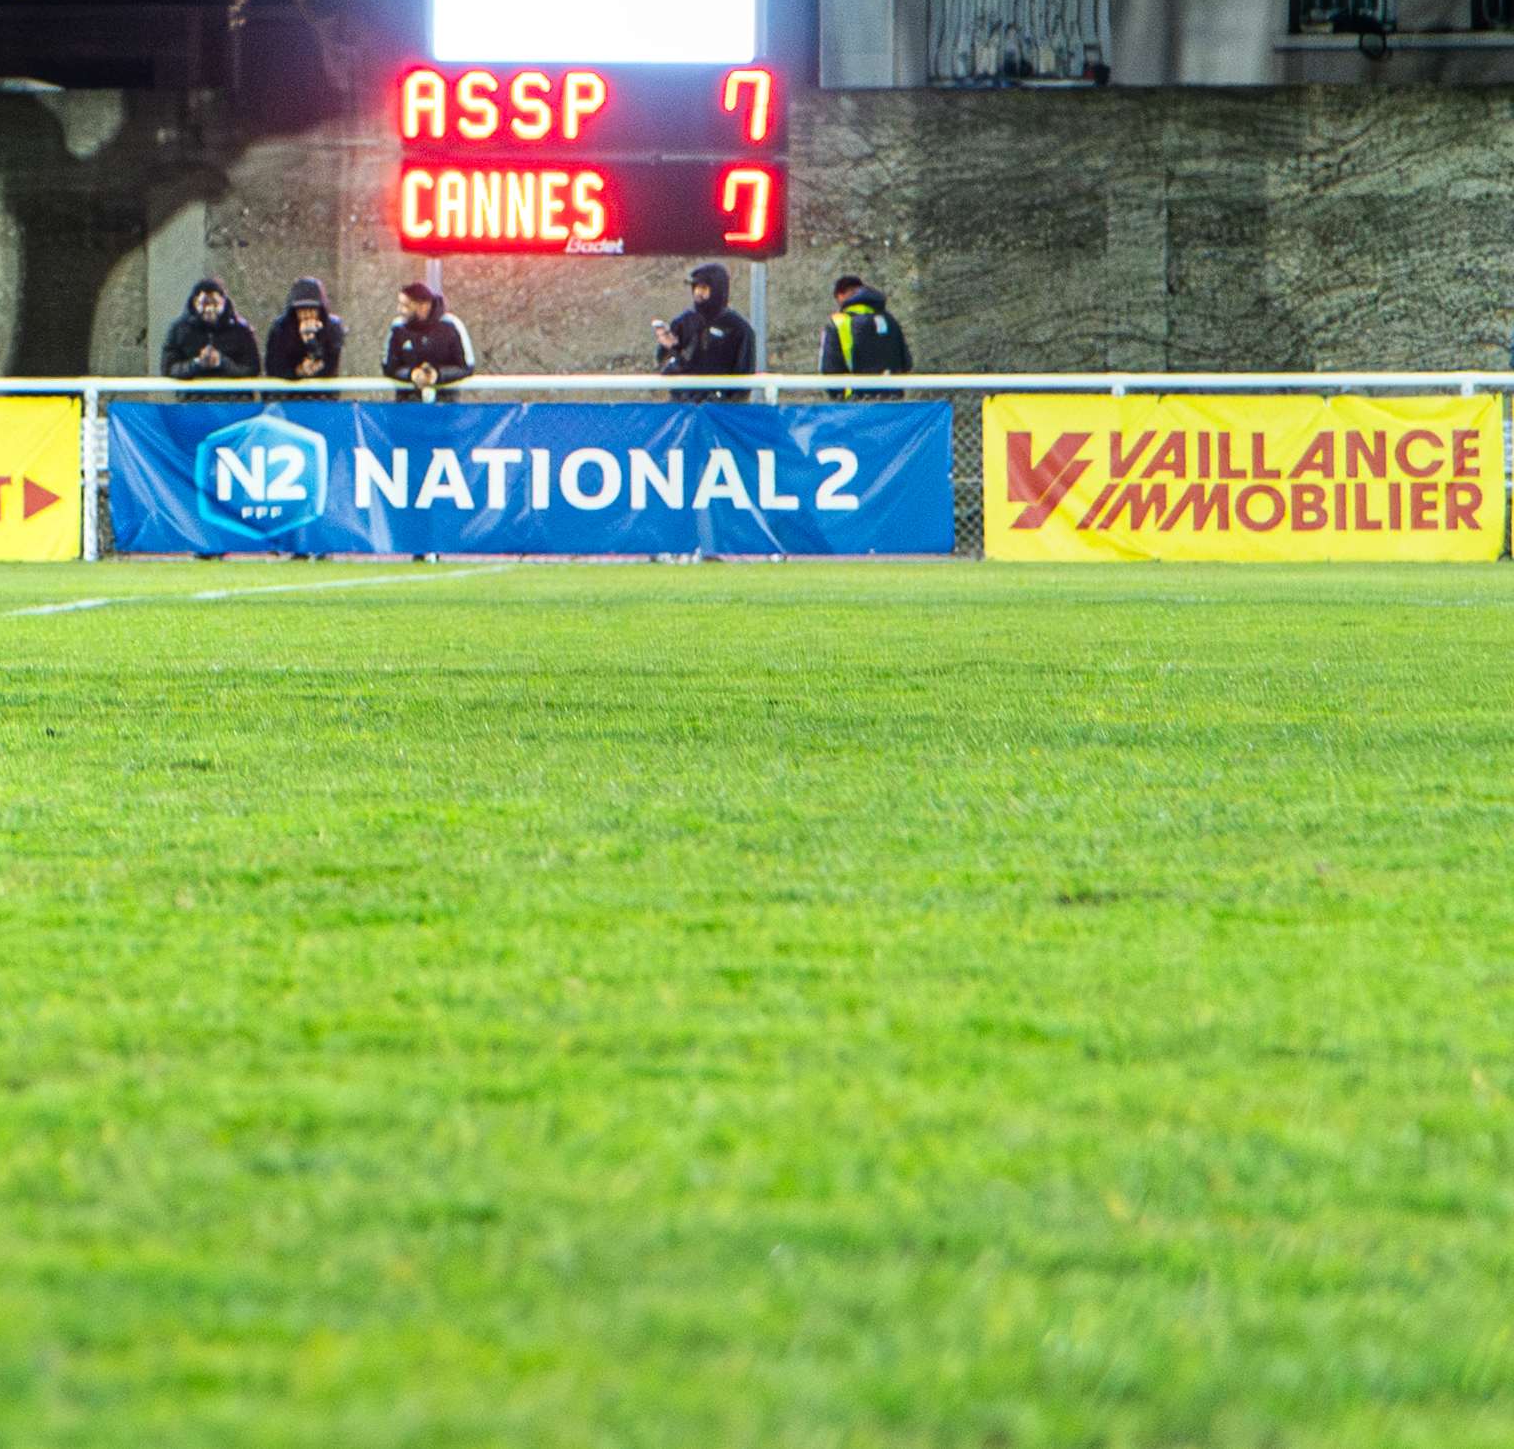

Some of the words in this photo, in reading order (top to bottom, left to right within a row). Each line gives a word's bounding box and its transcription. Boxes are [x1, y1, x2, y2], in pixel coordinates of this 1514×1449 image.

[400, 68, 609, 141] ASSP
[400, 168, 606, 241] CANNES
[215, 443, 308, 502] N2
[354, 448, 800, 511] NATIONAL
[816, 448, 859, 511] 2
[1108, 429, 1482, 479] VAILLANCE
[241, 506, 283, 519] FFF
[1076, 482, 1483, 531] IMMOBILIER
